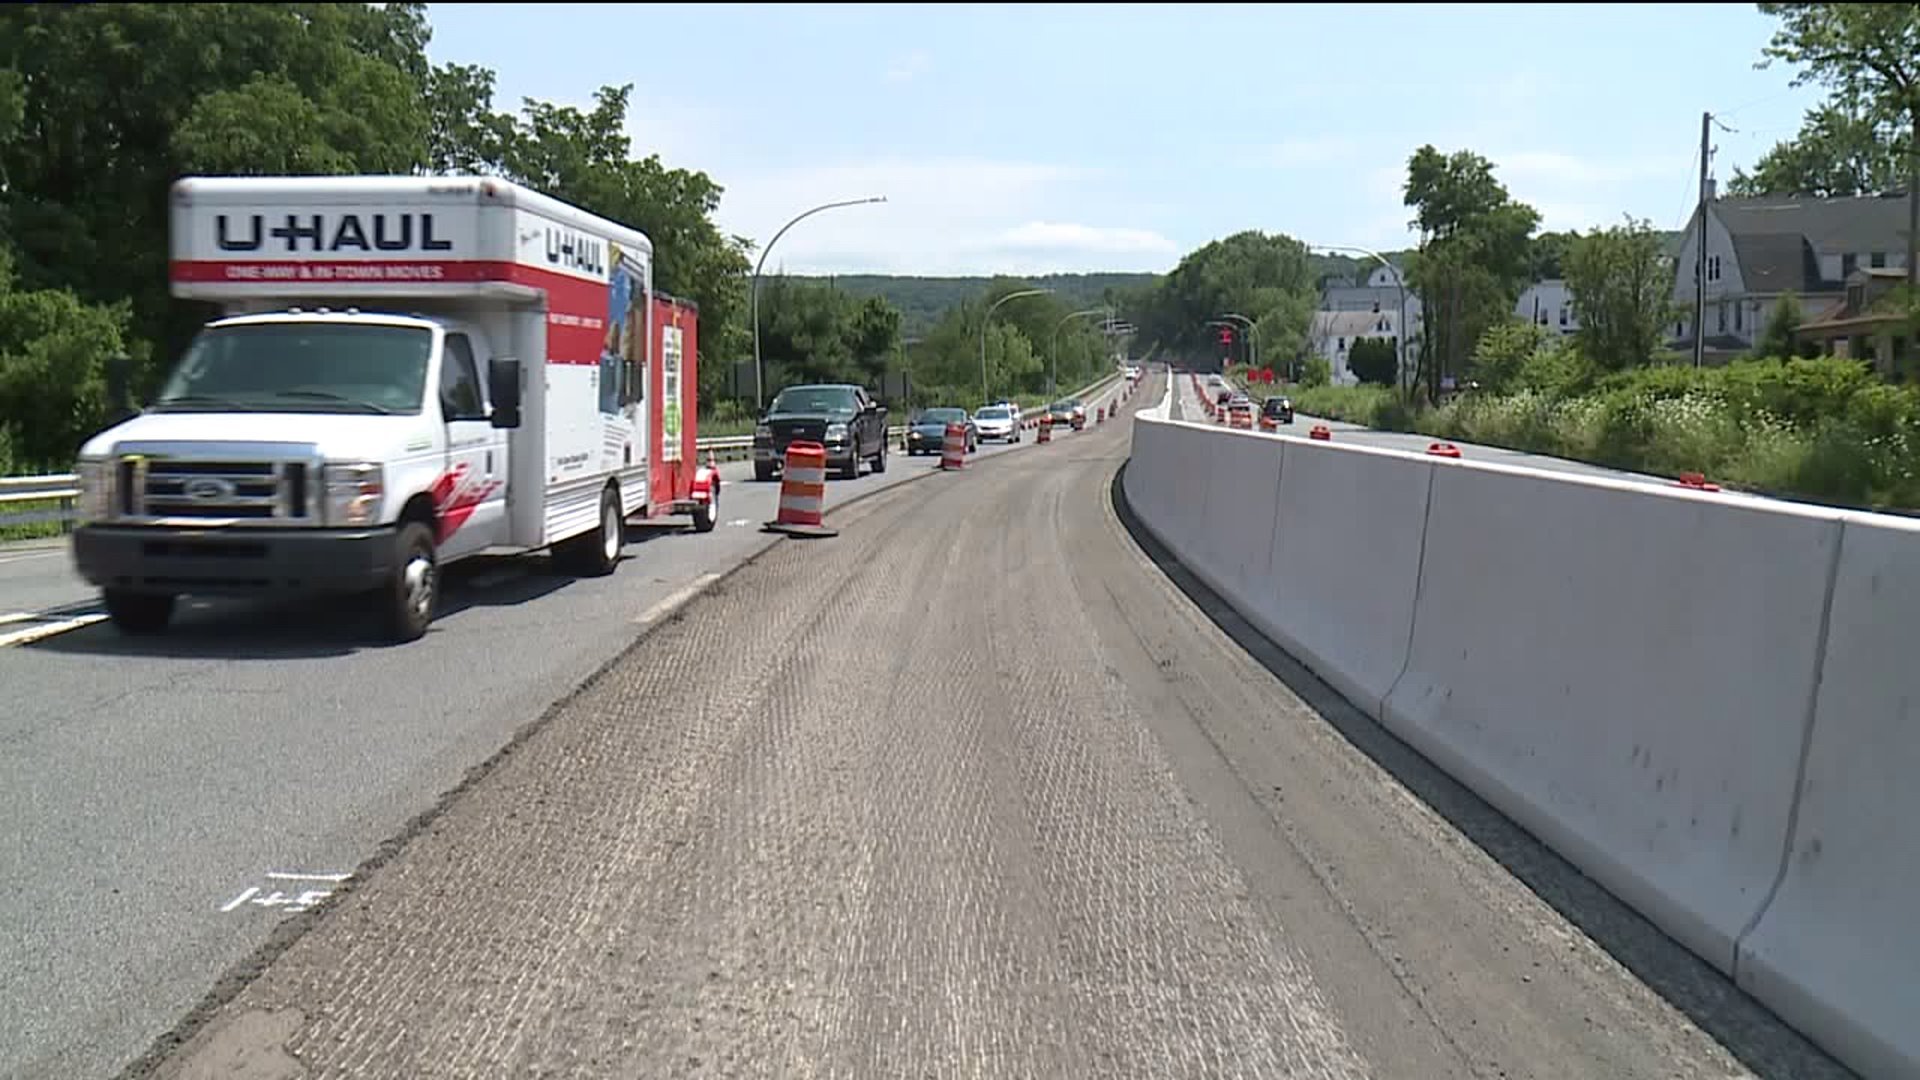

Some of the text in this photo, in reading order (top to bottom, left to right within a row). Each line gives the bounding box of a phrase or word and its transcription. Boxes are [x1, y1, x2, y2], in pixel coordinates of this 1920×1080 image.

[216, 214, 452, 251] U-HAUL
[545, 227, 603, 275] U-HAUL
[385, 265, 444, 279] MOVES
